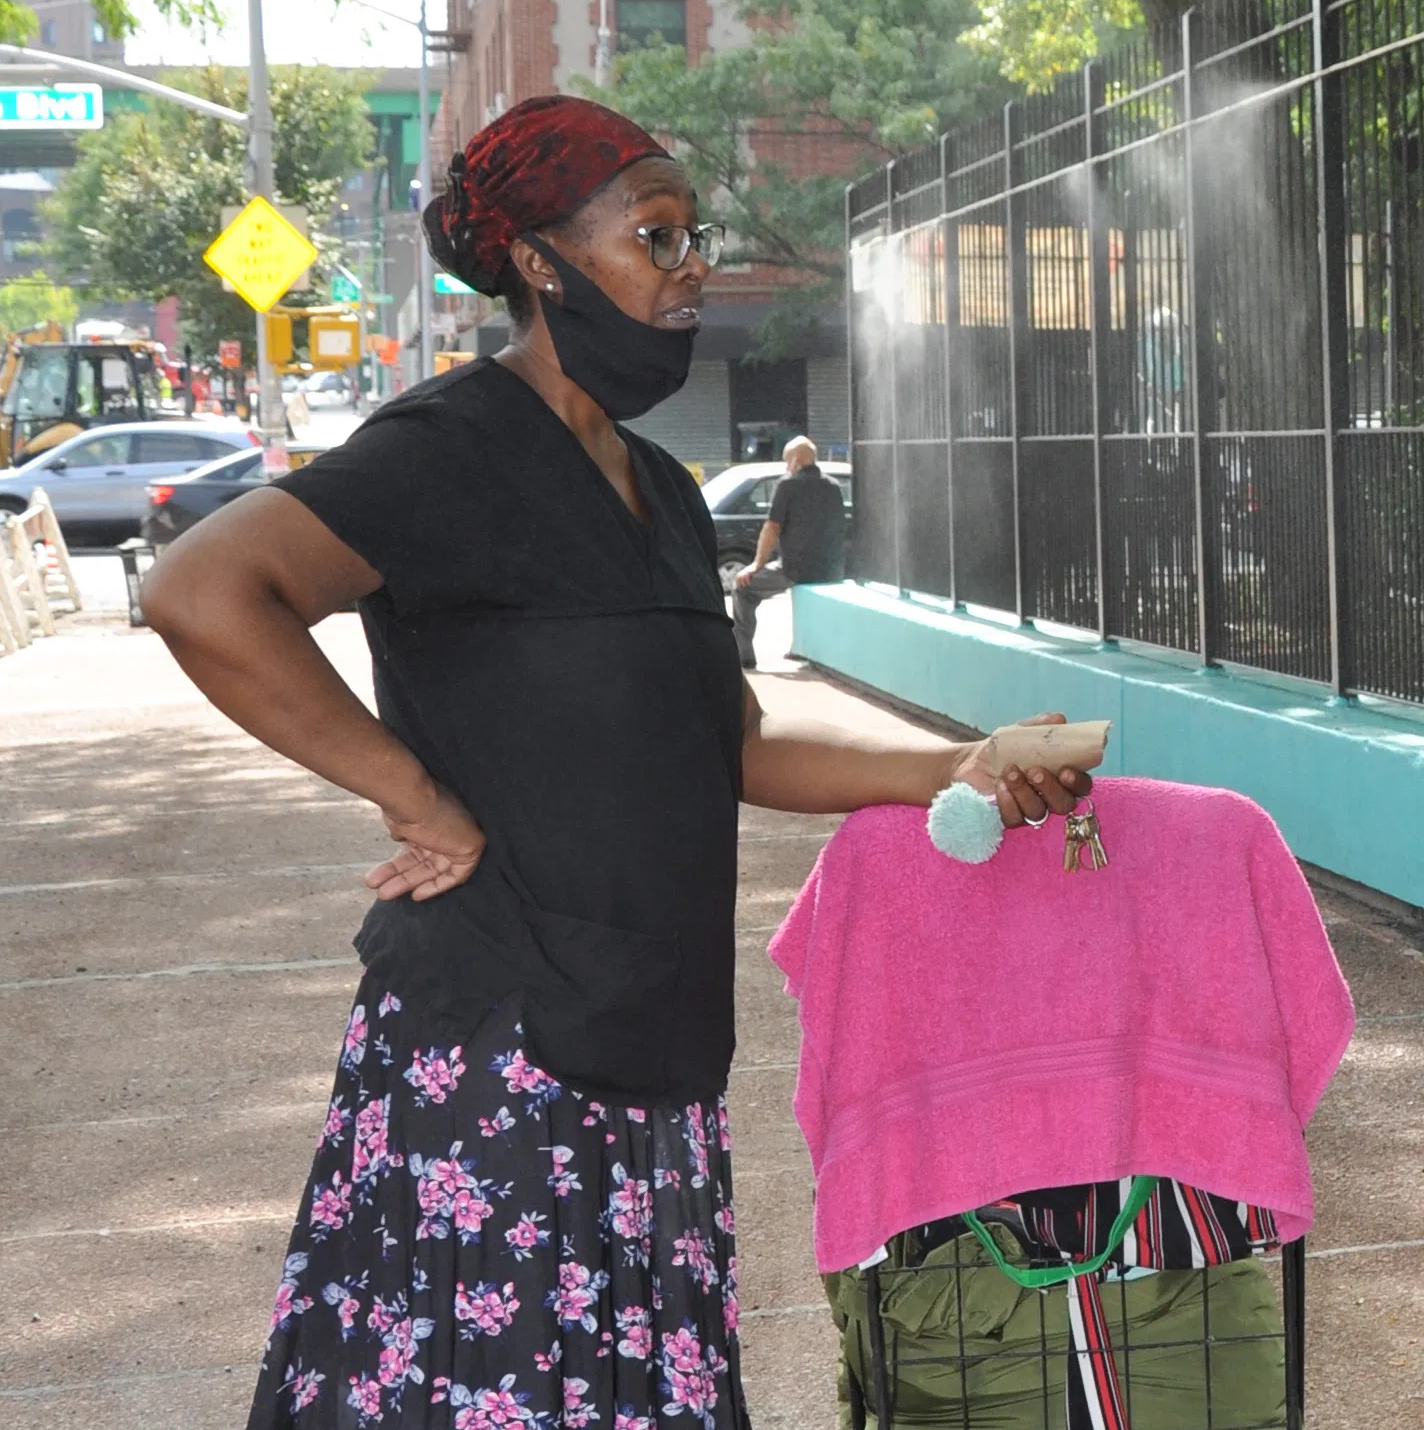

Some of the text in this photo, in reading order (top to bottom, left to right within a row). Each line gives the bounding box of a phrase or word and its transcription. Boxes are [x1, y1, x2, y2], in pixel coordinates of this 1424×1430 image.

[16, 92, 86, 120] Blvd
[237, 254, 285, 266] TRAFFIC
[243, 271, 282, 283] AHEAD
